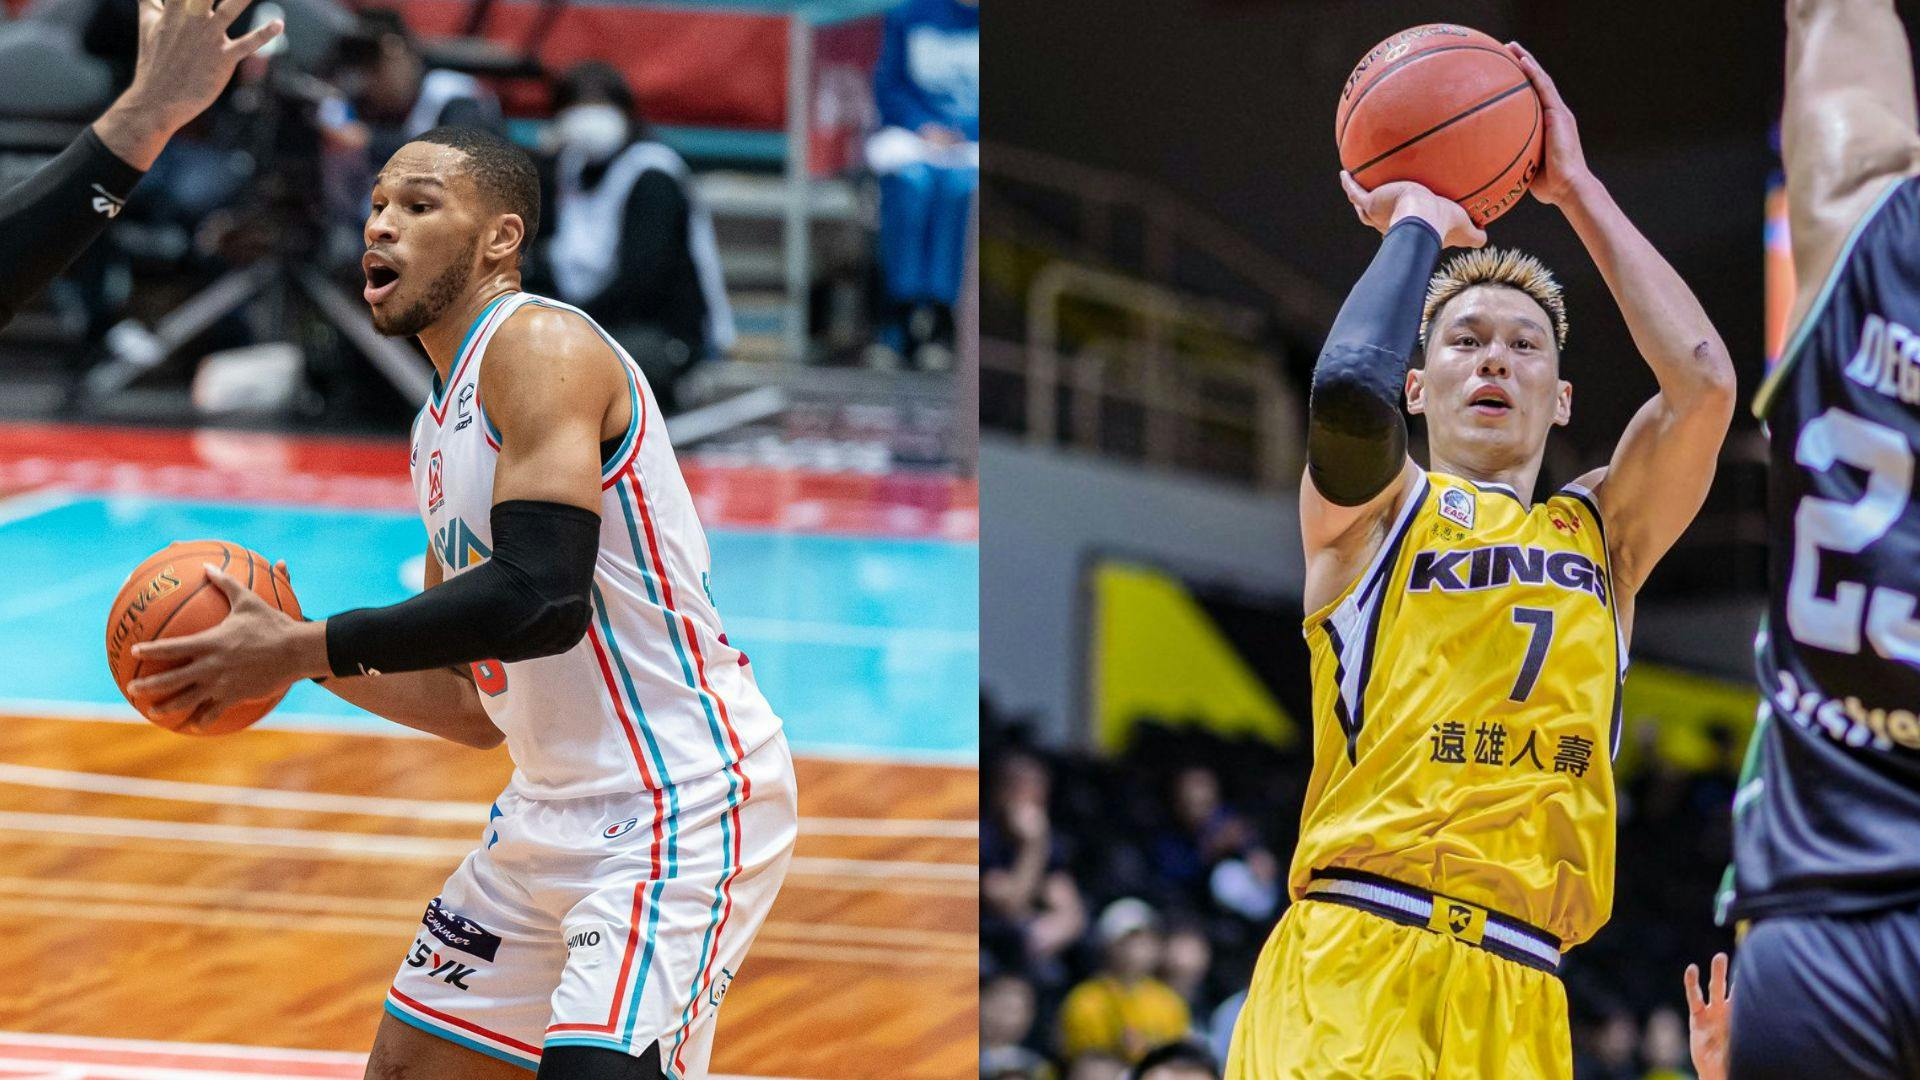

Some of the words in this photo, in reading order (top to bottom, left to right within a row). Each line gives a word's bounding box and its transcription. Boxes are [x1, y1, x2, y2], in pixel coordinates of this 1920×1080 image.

[1443, 506, 1469, 524] EASL
[1407, 545, 1607, 607] KINGS
[1509, 607, 1554, 703] 7
[1429, 720, 1594, 778] 遠雄人壽
[426, 908, 471, 946] Engineer
